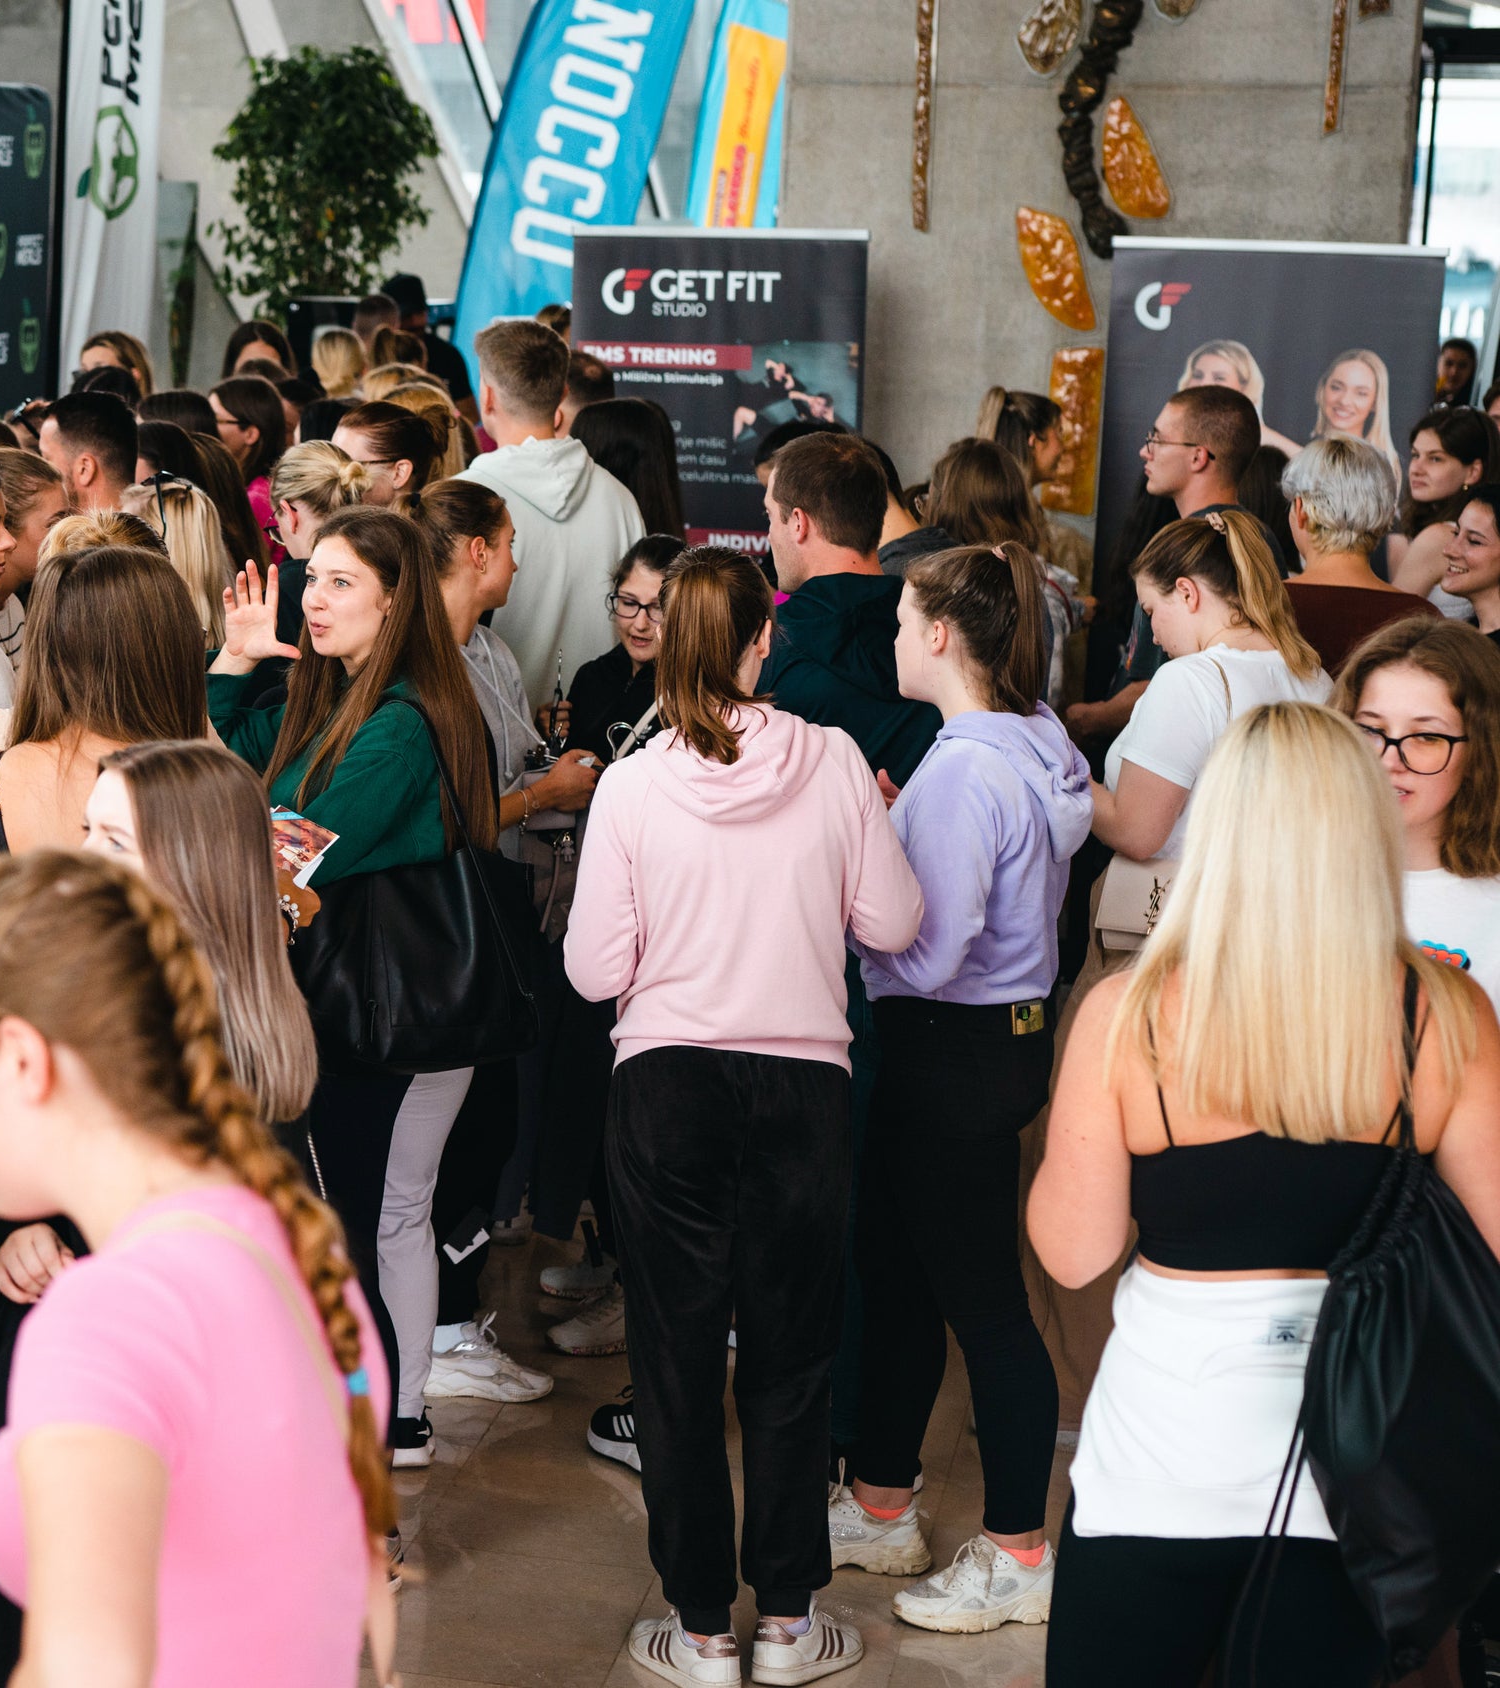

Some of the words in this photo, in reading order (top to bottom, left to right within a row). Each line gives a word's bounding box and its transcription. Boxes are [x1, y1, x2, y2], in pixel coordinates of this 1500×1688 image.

[650, 268, 724, 301] GET
[726, 270, 782, 303] FIT
[651, 301, 707, 318] STUDIO
[628, 346, 717, 366] TRENING
